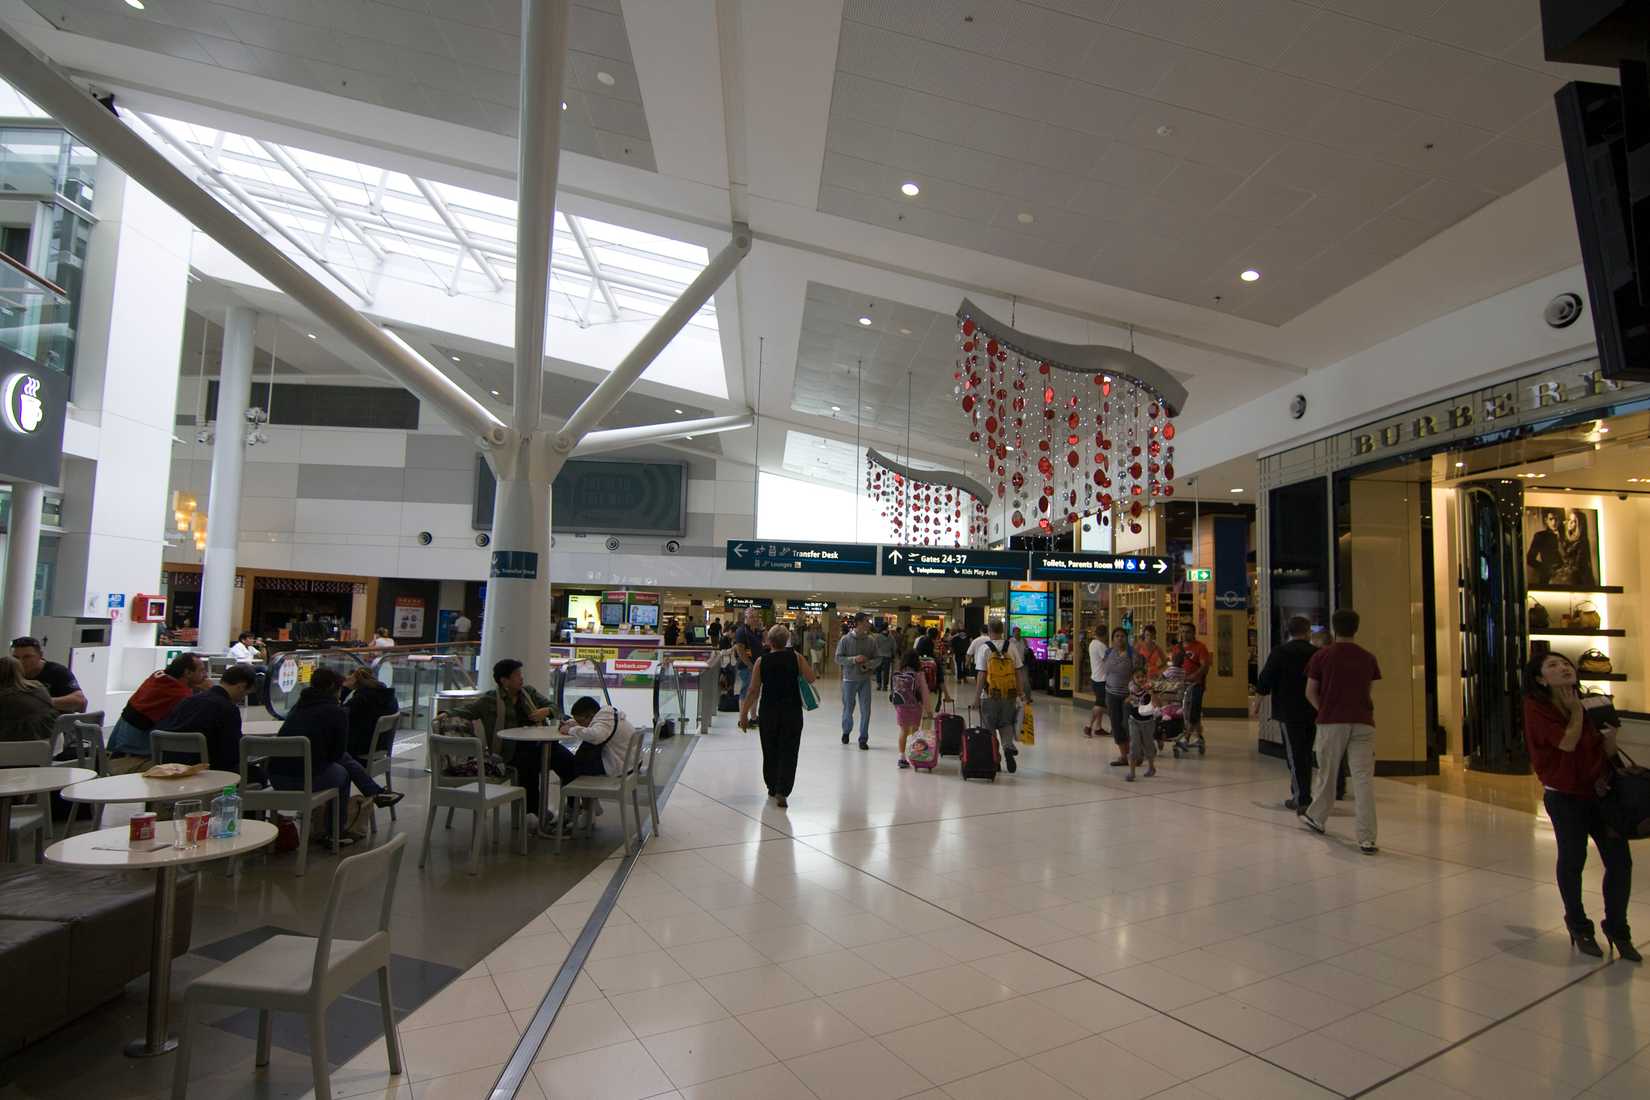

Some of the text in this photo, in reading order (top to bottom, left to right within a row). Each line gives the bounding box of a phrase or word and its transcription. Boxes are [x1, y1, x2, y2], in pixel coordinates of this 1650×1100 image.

[793, 550, 838, 559] Transfer Desk
[921, 554, 967, 564] Gates 24-37
[1042, 559, 1112, 569] Toilets, Parents Room
[974, 569, 985, 577] Play
